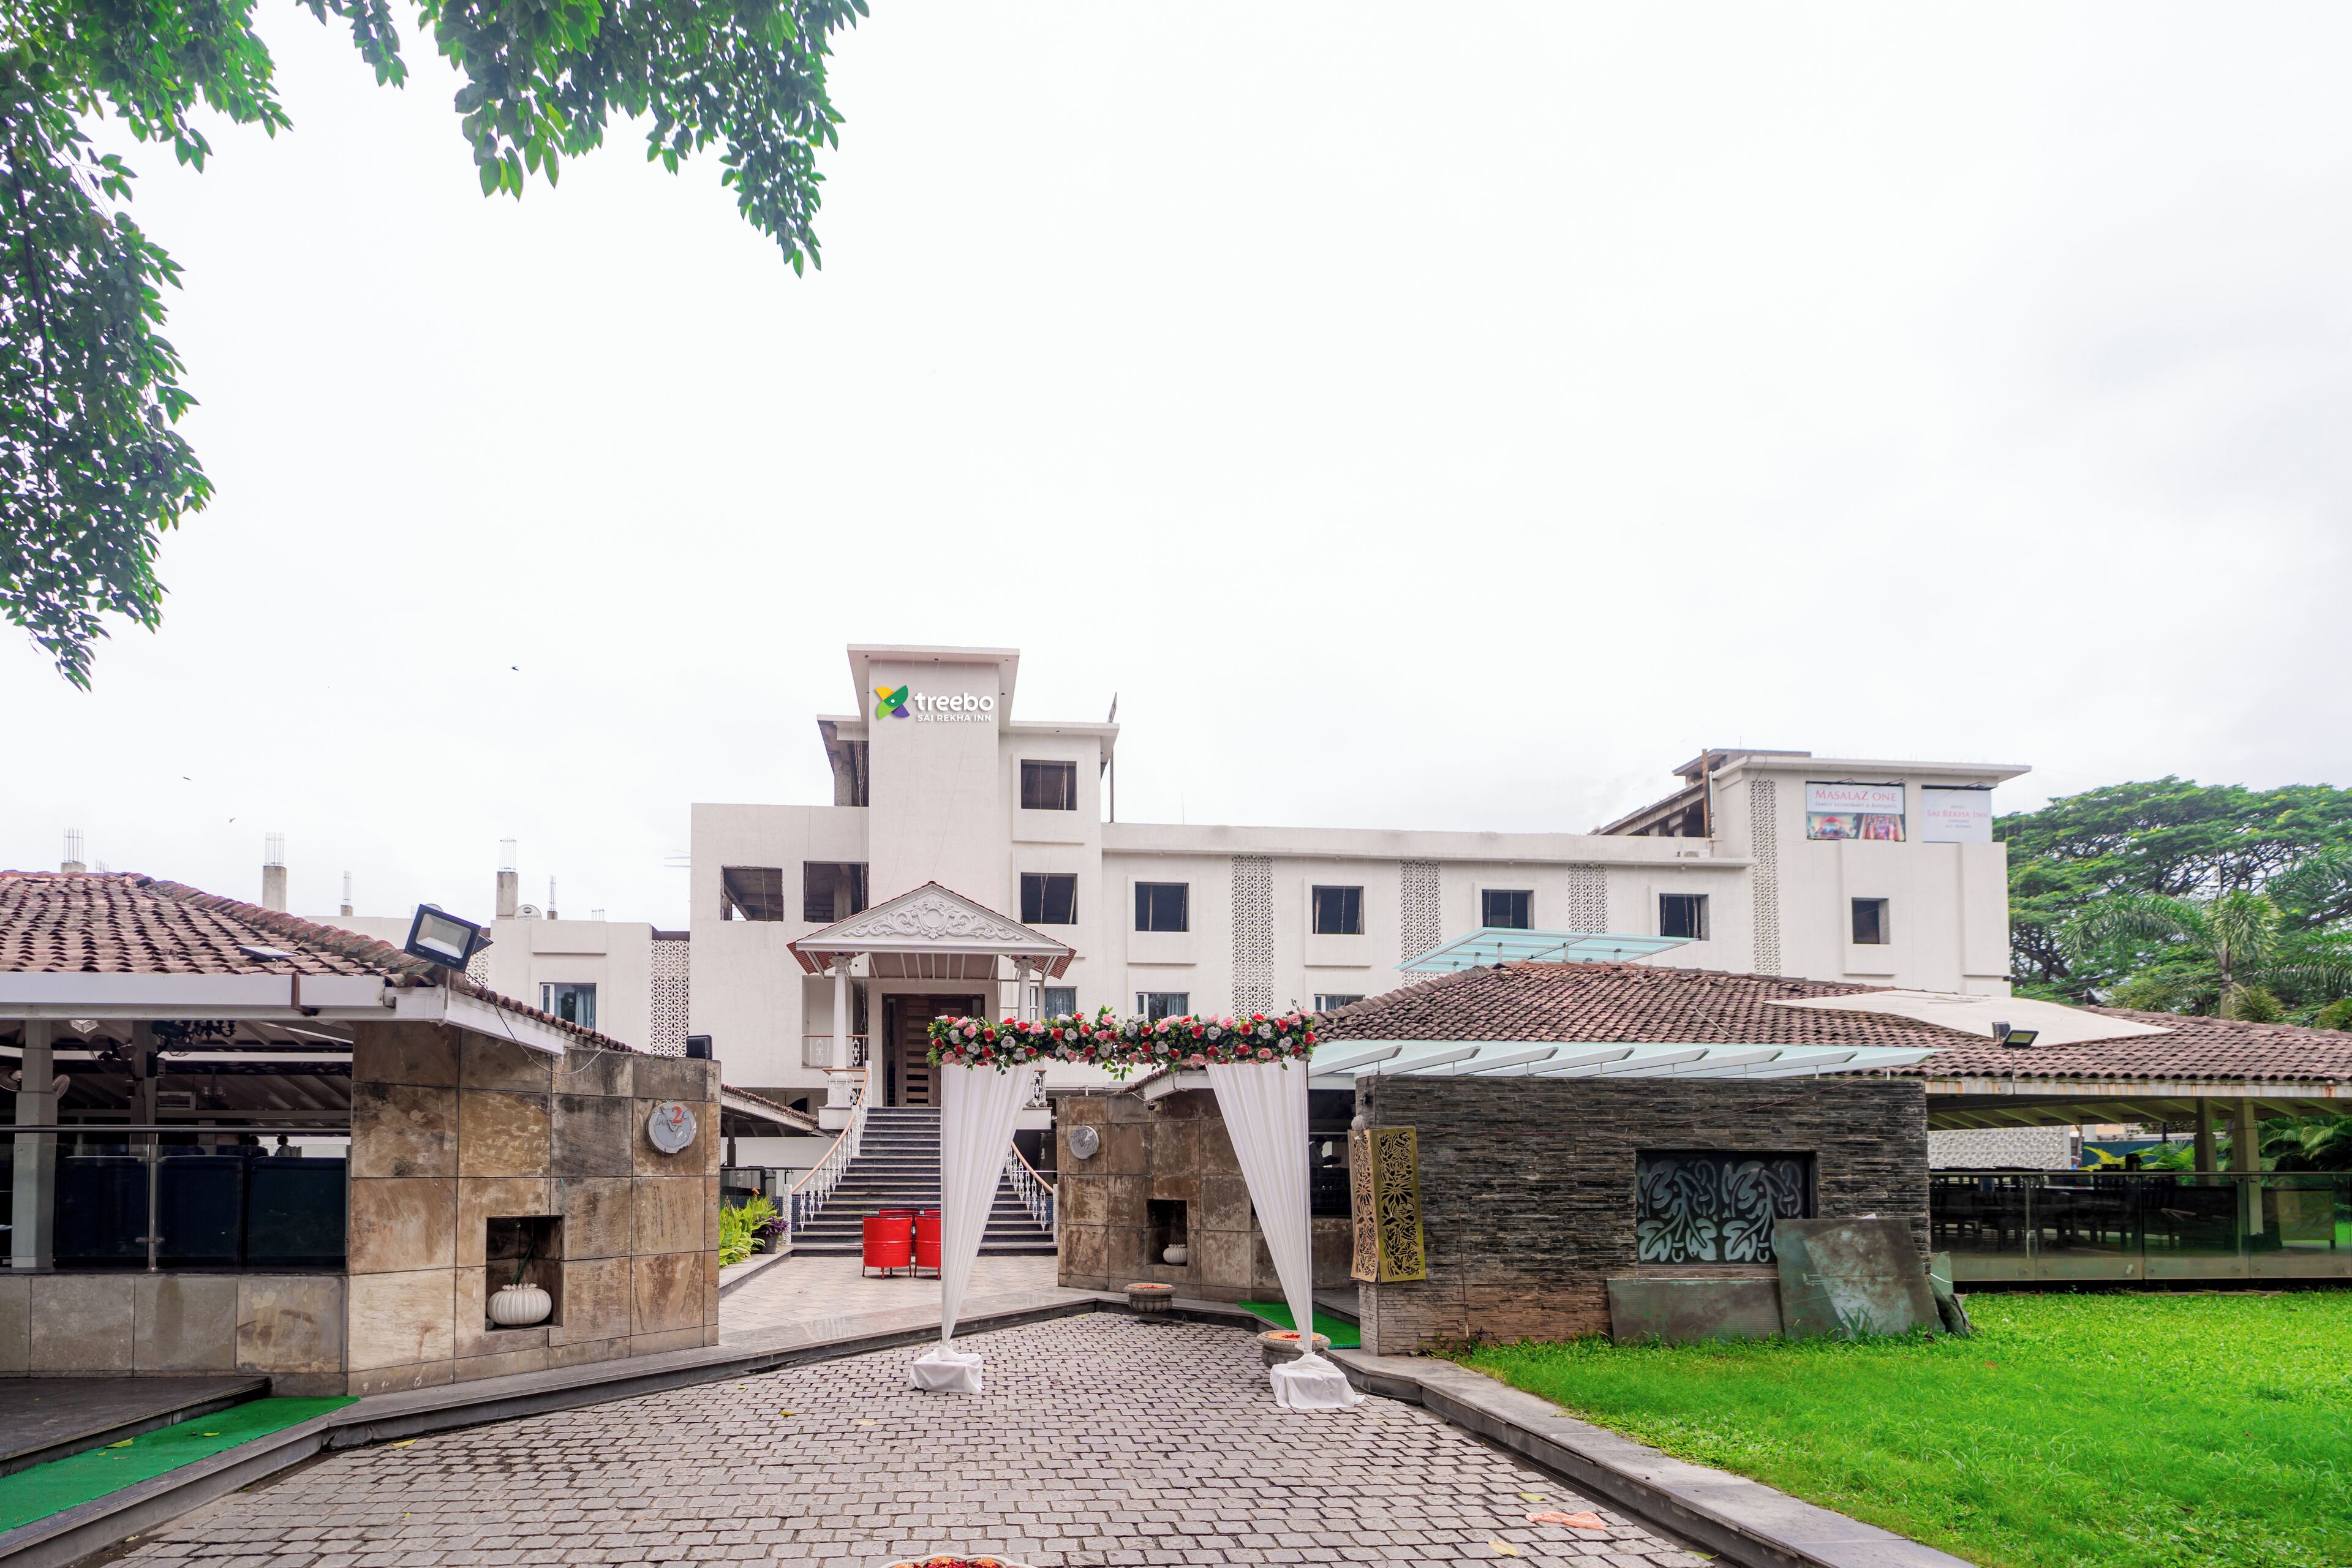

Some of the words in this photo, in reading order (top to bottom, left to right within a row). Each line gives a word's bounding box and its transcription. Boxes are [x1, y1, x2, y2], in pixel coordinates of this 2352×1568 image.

[914, 693, 994, 711] treebo
[1872, 792, 1896, 801] ONE
[672, 1106, 682, 1123] 2
